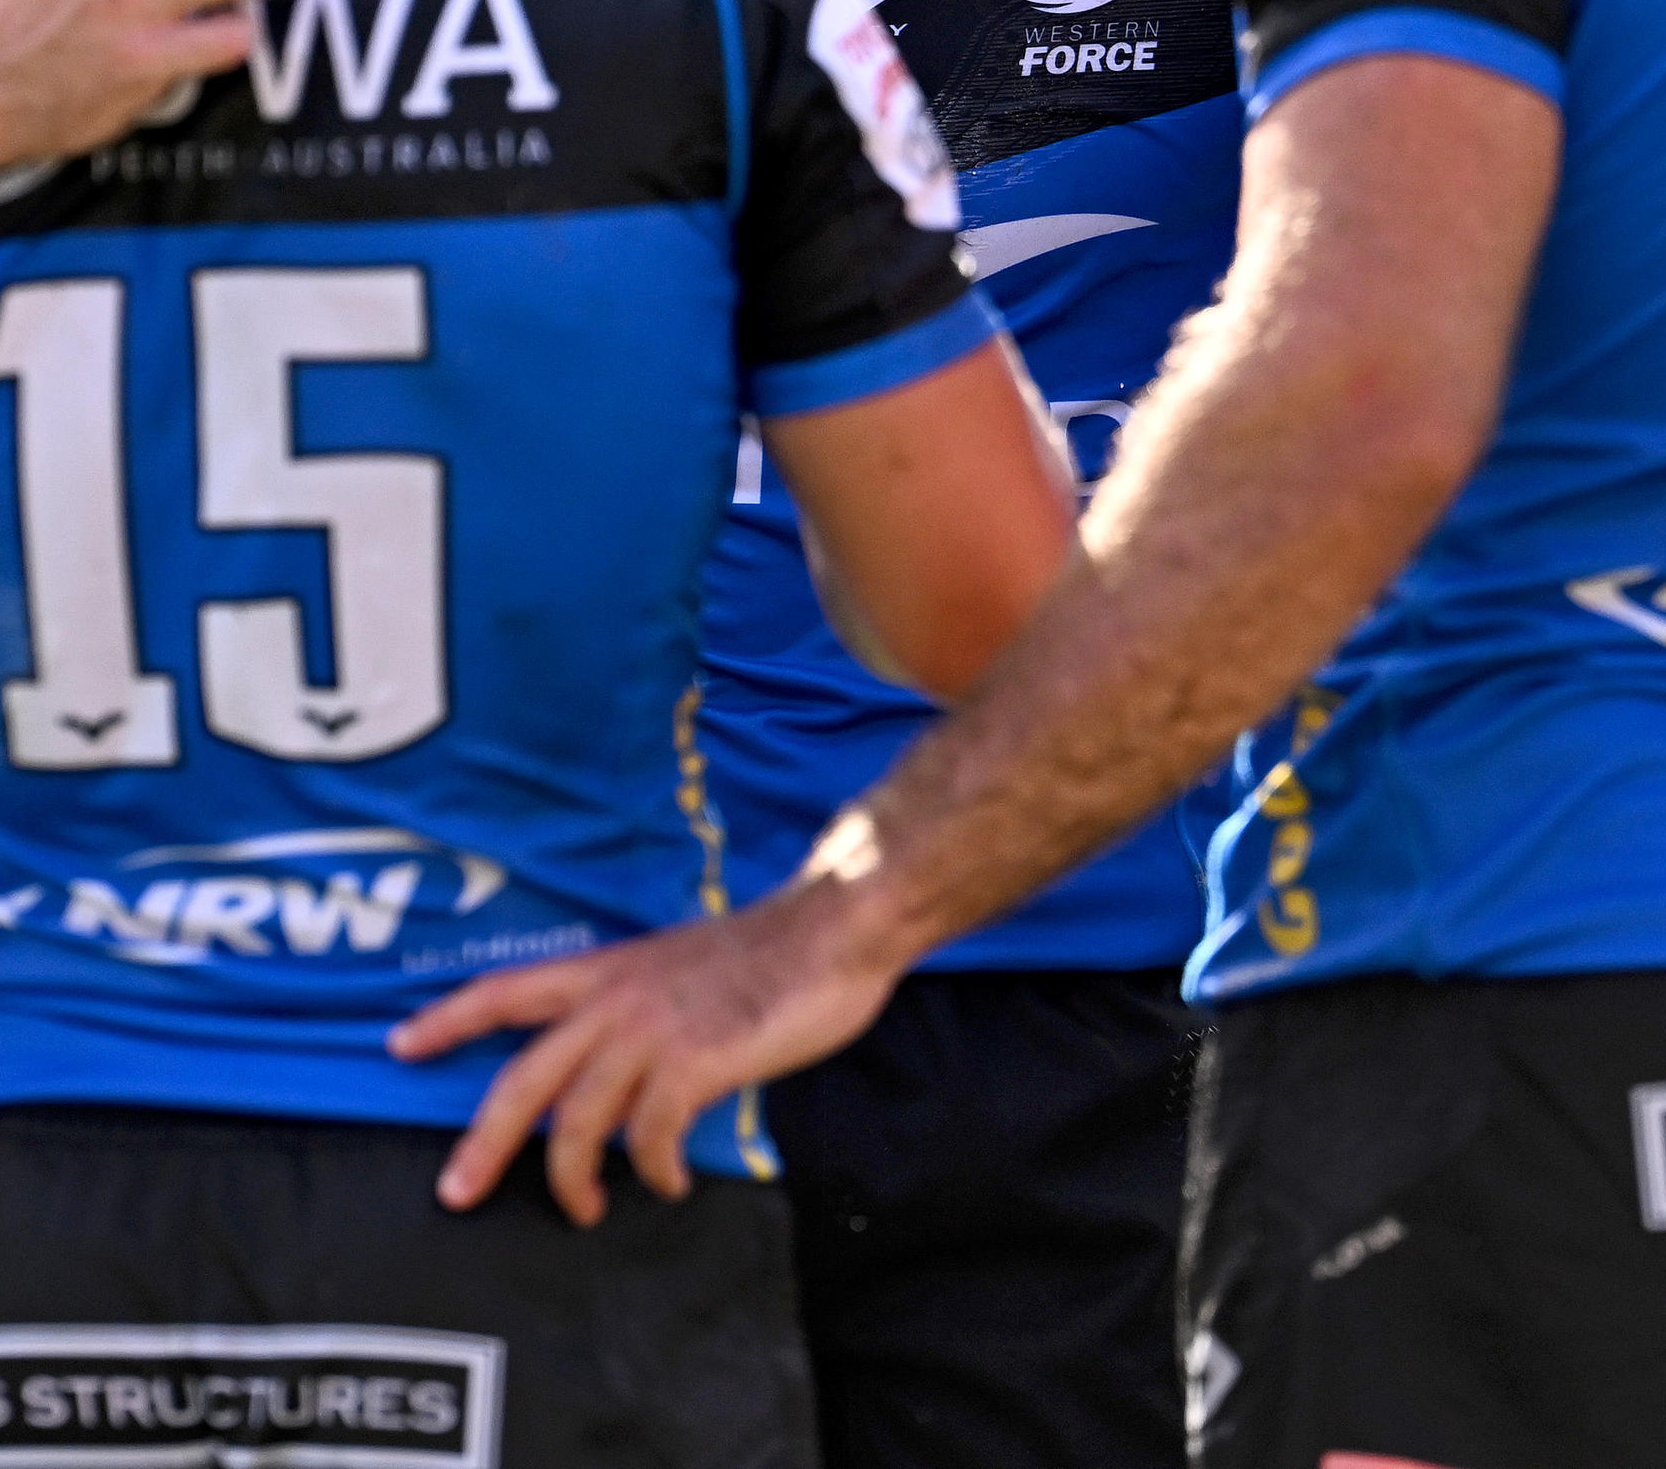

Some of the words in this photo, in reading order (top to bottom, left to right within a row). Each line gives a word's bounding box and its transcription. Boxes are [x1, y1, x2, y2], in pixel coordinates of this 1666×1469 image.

[1024, 20, 1161, 44] WESTERN
[1019, 40, 1159, 77] FORCE
[260, 126, 554, 178] AUSTRALIA
[61, 861, 423, 957] NRW
[20, 1373, 461, 1434] STRUCTURES
